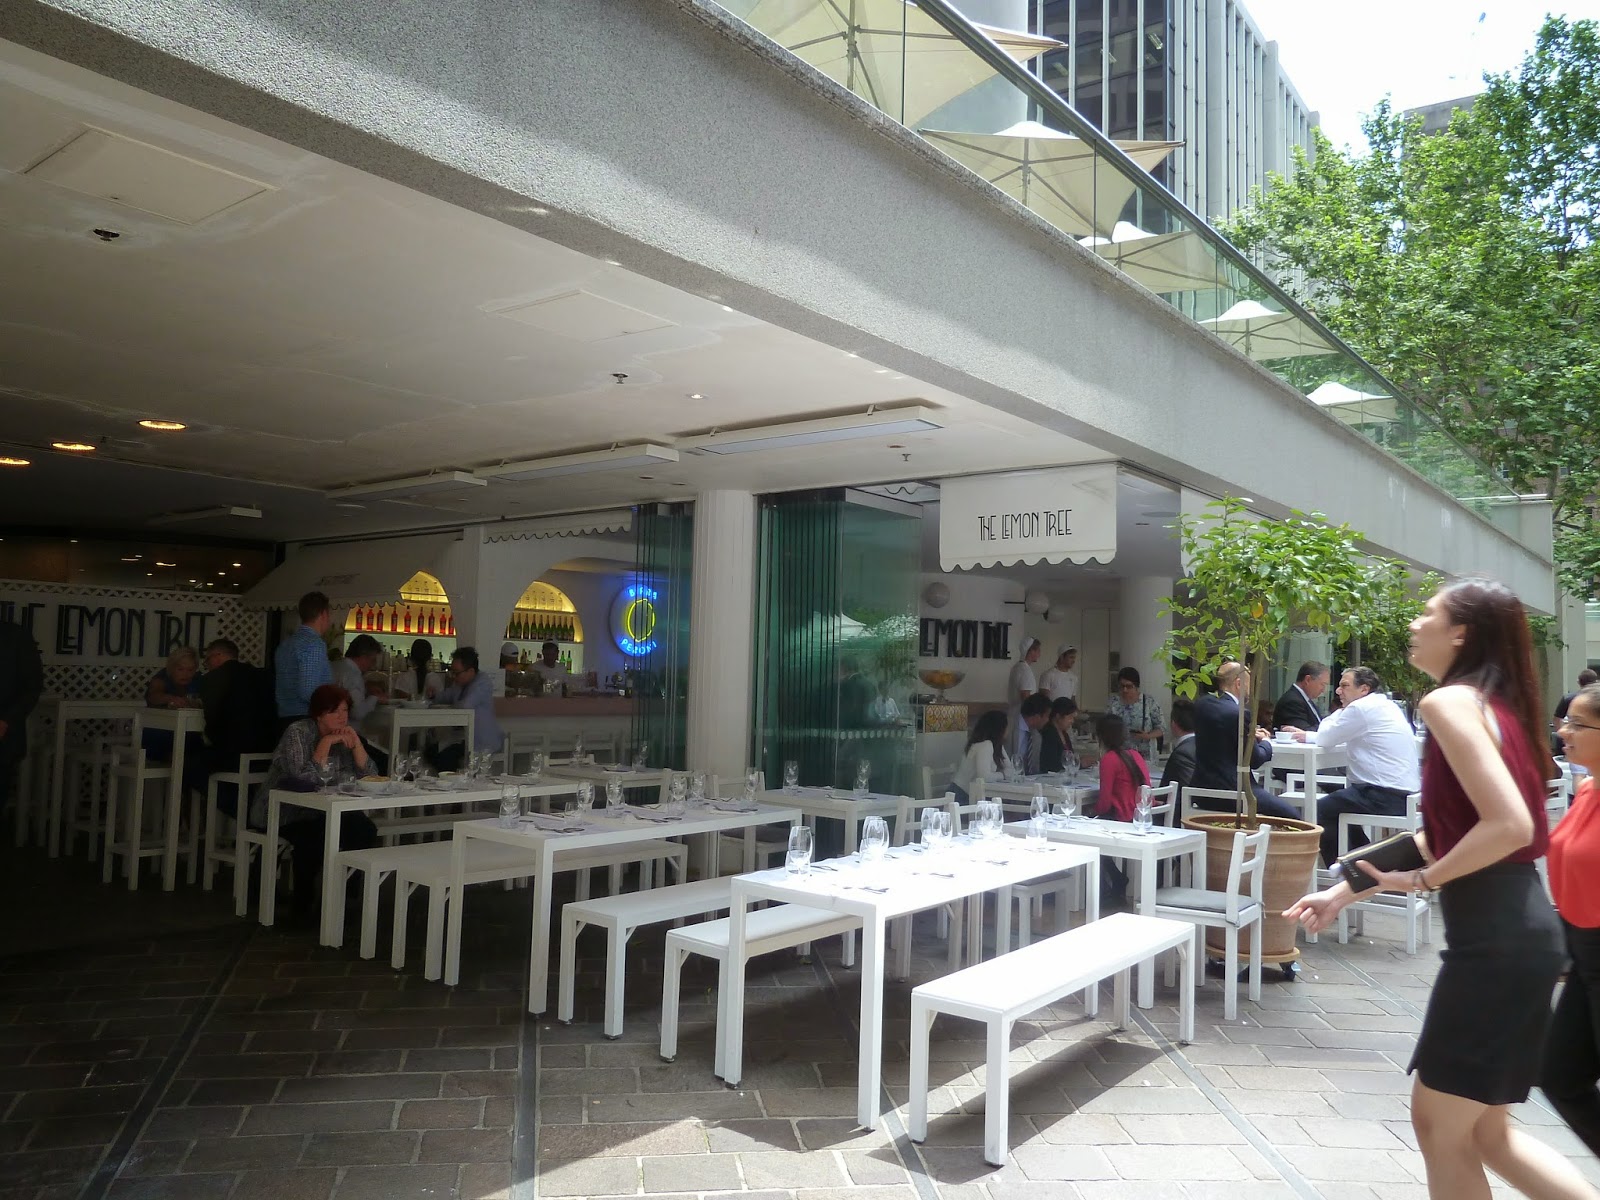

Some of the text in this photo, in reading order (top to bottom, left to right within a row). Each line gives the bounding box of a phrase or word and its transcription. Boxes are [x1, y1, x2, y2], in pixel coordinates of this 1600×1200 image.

[977, 509, 1073, 541] THE LEMON TREE
[56, 604, 146, 657] LEMON
[621, 638, 658, 655] PERONI
[919, 617, 979, 658] LEMON
